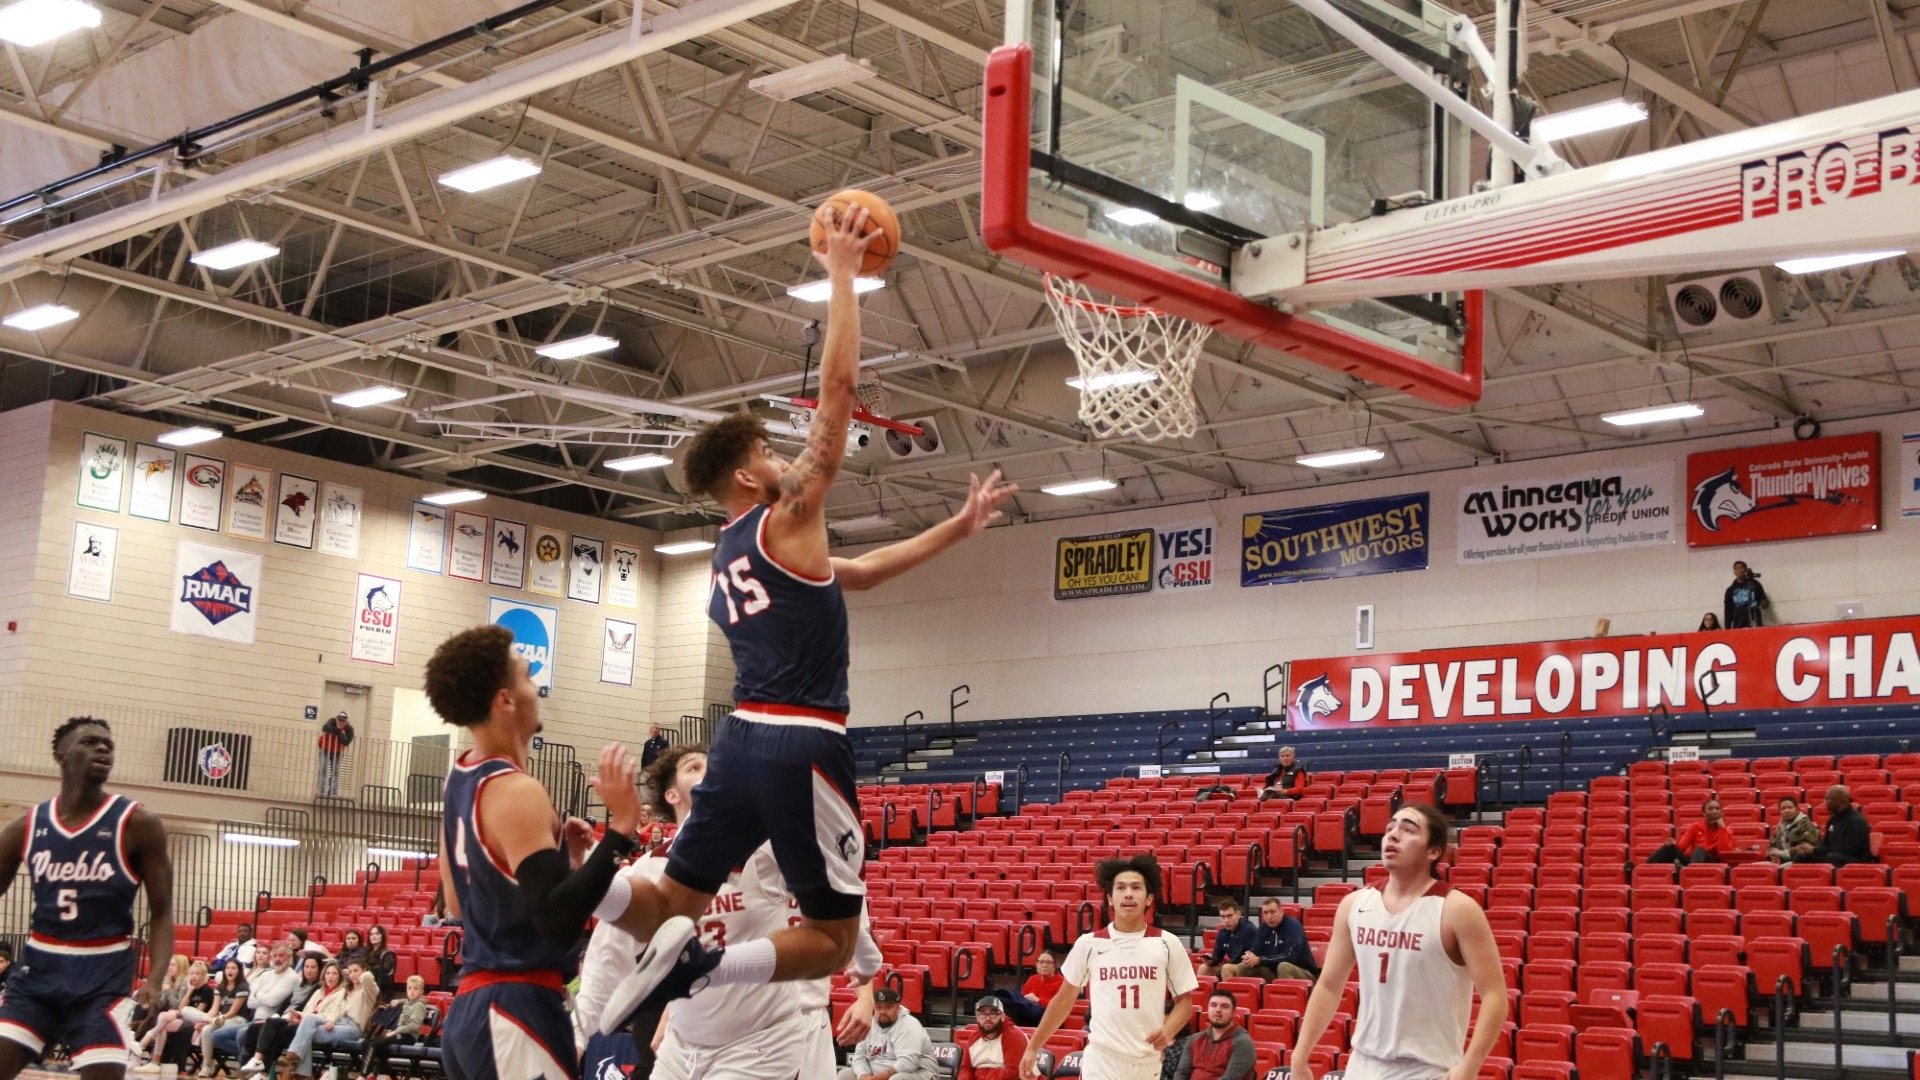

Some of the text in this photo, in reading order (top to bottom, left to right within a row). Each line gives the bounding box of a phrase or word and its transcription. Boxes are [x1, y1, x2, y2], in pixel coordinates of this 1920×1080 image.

[1424, 194, 1502, 221] ULTRA-PRO
[1749, 461, 1781, 472] Colorado
[1783, 459, 1802, 468] State
[1750, 463, 1870, 500] ThunderWolves
[1586, 506, 1670, 525] CREDIT UNION
[1617, 484, 1654, 526] you
[1159, 528, 1212, 560] YES!
[1245, 503, 1423, 571] SOUTHWEST
[1339, 531, 1425, 567] MOTORS
[1064, 540, 1147, 579] SPRADLEY
[1174, 560, 1212, 582] CSU
[717, 554, 771, 625] 15
[1061, 583, 1146, 597] WWW.SPRADLEY.COM
[1068, 573, 1141, 588] OH YES YOU CAN!
[1173, 579, 1212, 588] PUEBLO
[186, 578, 249, 609] RMAC
[360, 624, 392, 635] PUEBLO
[361, 608, 393, 628] CSU
[514, 642, 547, 664] CAA
[1349, 642, 1737, 722] DEVELOPING
[1671, 751, 1697, 759] SECTION
[31, 849, 116, 884] Pueblo
[57, 888, 78, 921] 5
[694, 920, 727, 951] 3
[1356, 926, 1424, 952] BACONE
[1099, 965, 1158, 981] BACONE
[1378, 951, 1390, 984] 1
[1117, 984, 1140, 1009] 11
[933, 1047, 957, 1058] ACK
[1063, 1055, 1083, 1068] PAC
[1266, 1070, 1291, 1080] PAC
